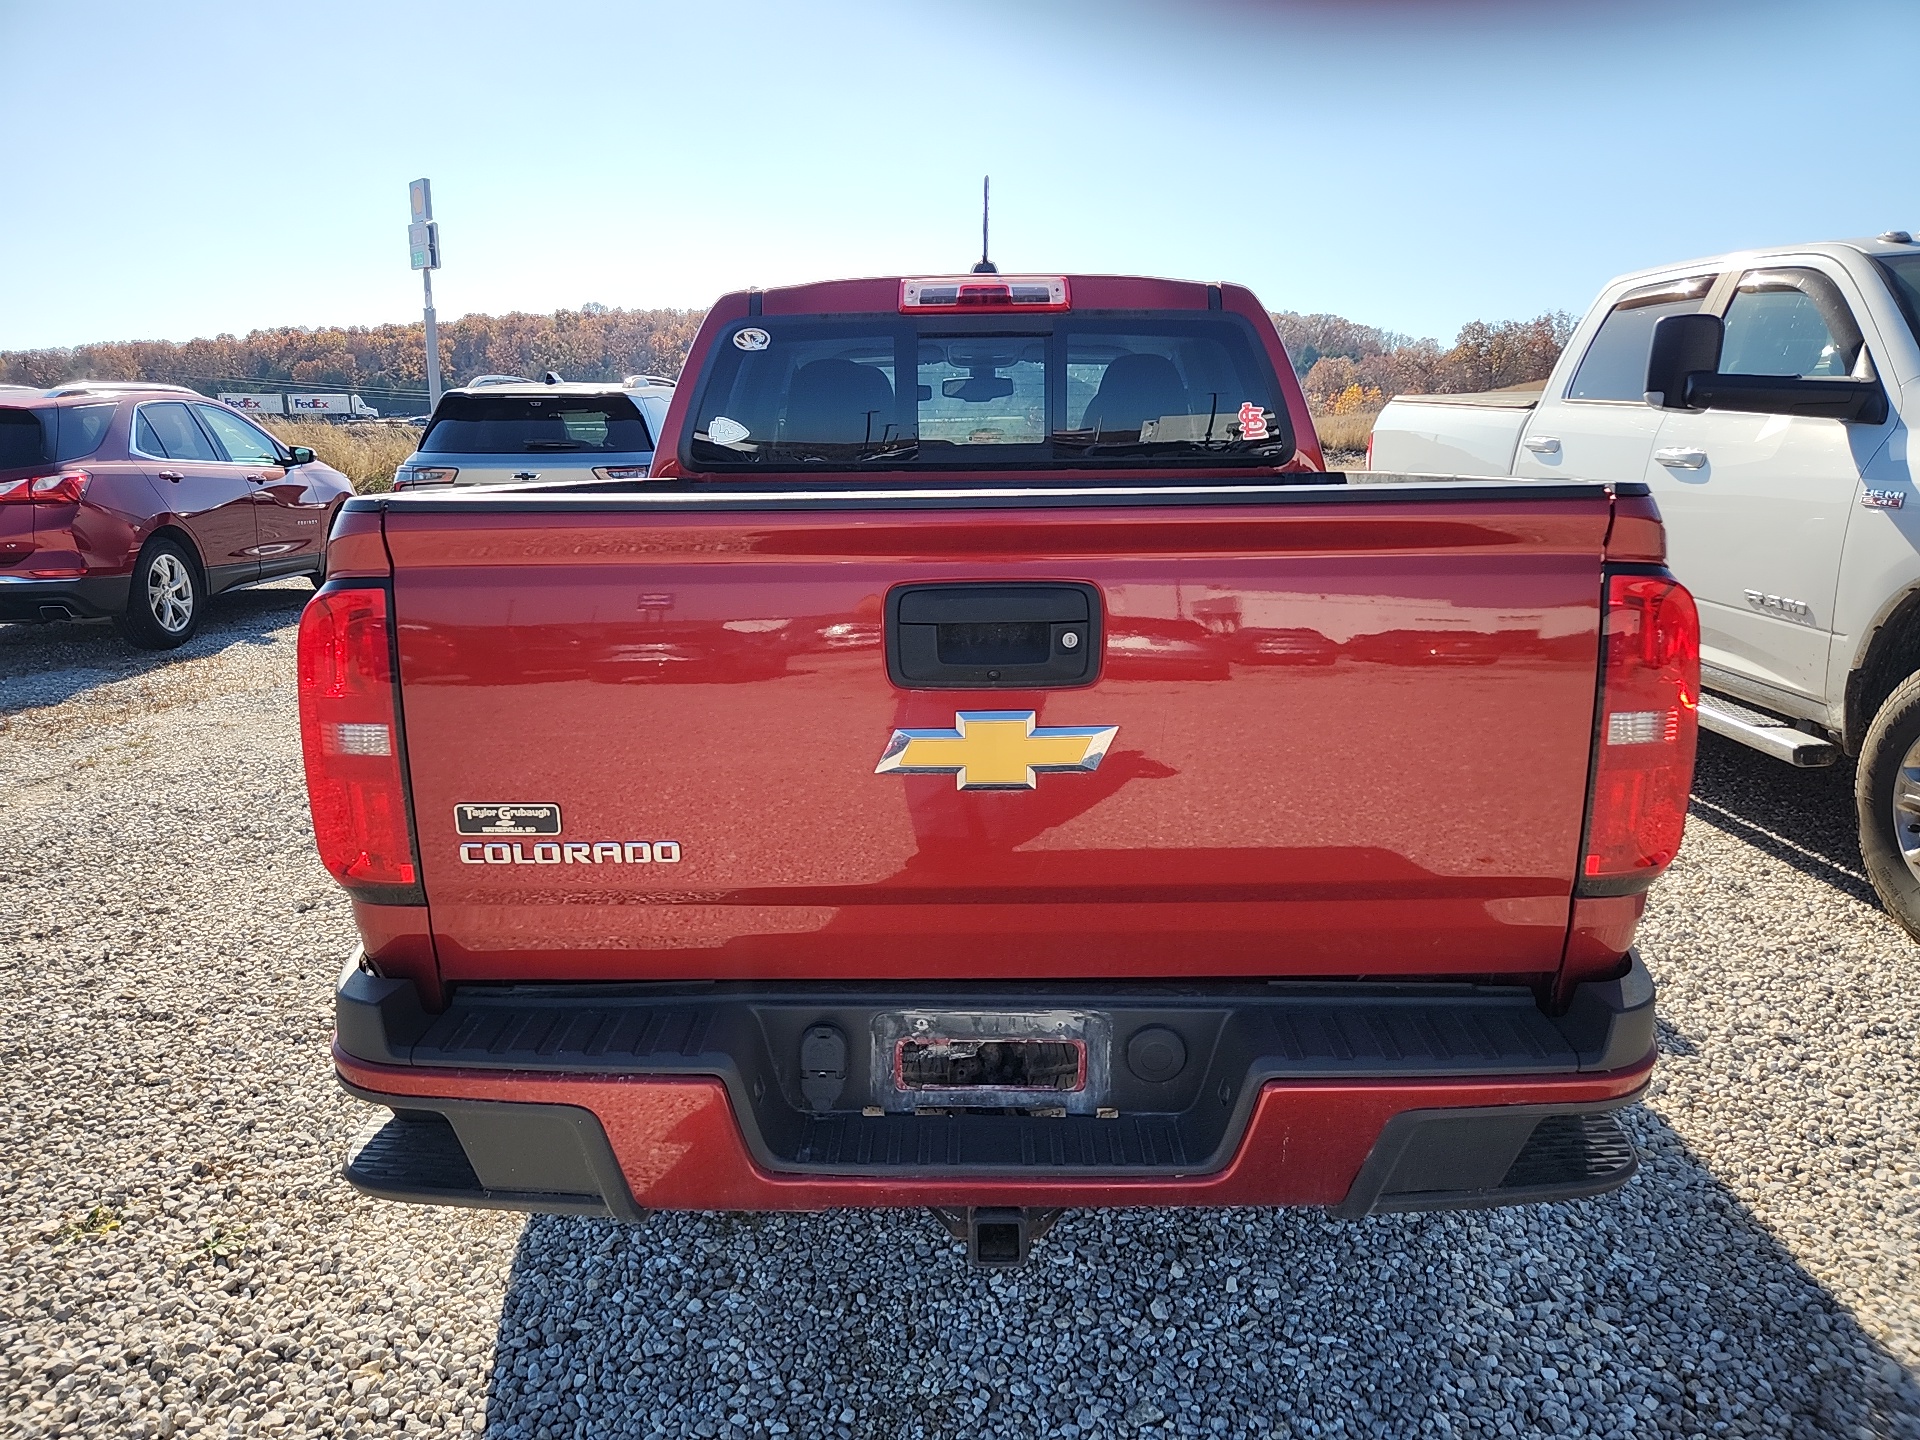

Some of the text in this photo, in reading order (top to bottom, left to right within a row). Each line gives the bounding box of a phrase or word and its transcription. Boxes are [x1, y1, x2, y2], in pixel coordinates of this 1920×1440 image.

[224, 398, 261, 408] FedEx
[294, 398, 329, 408] FedEx
[1862, 489, 1904, 500] HEMI
[1744, 588, 1807, 616] RAM
[462, 806, 550, 820] Taylor Grubaugh
[459, 841, 681, 864] COLORADO
